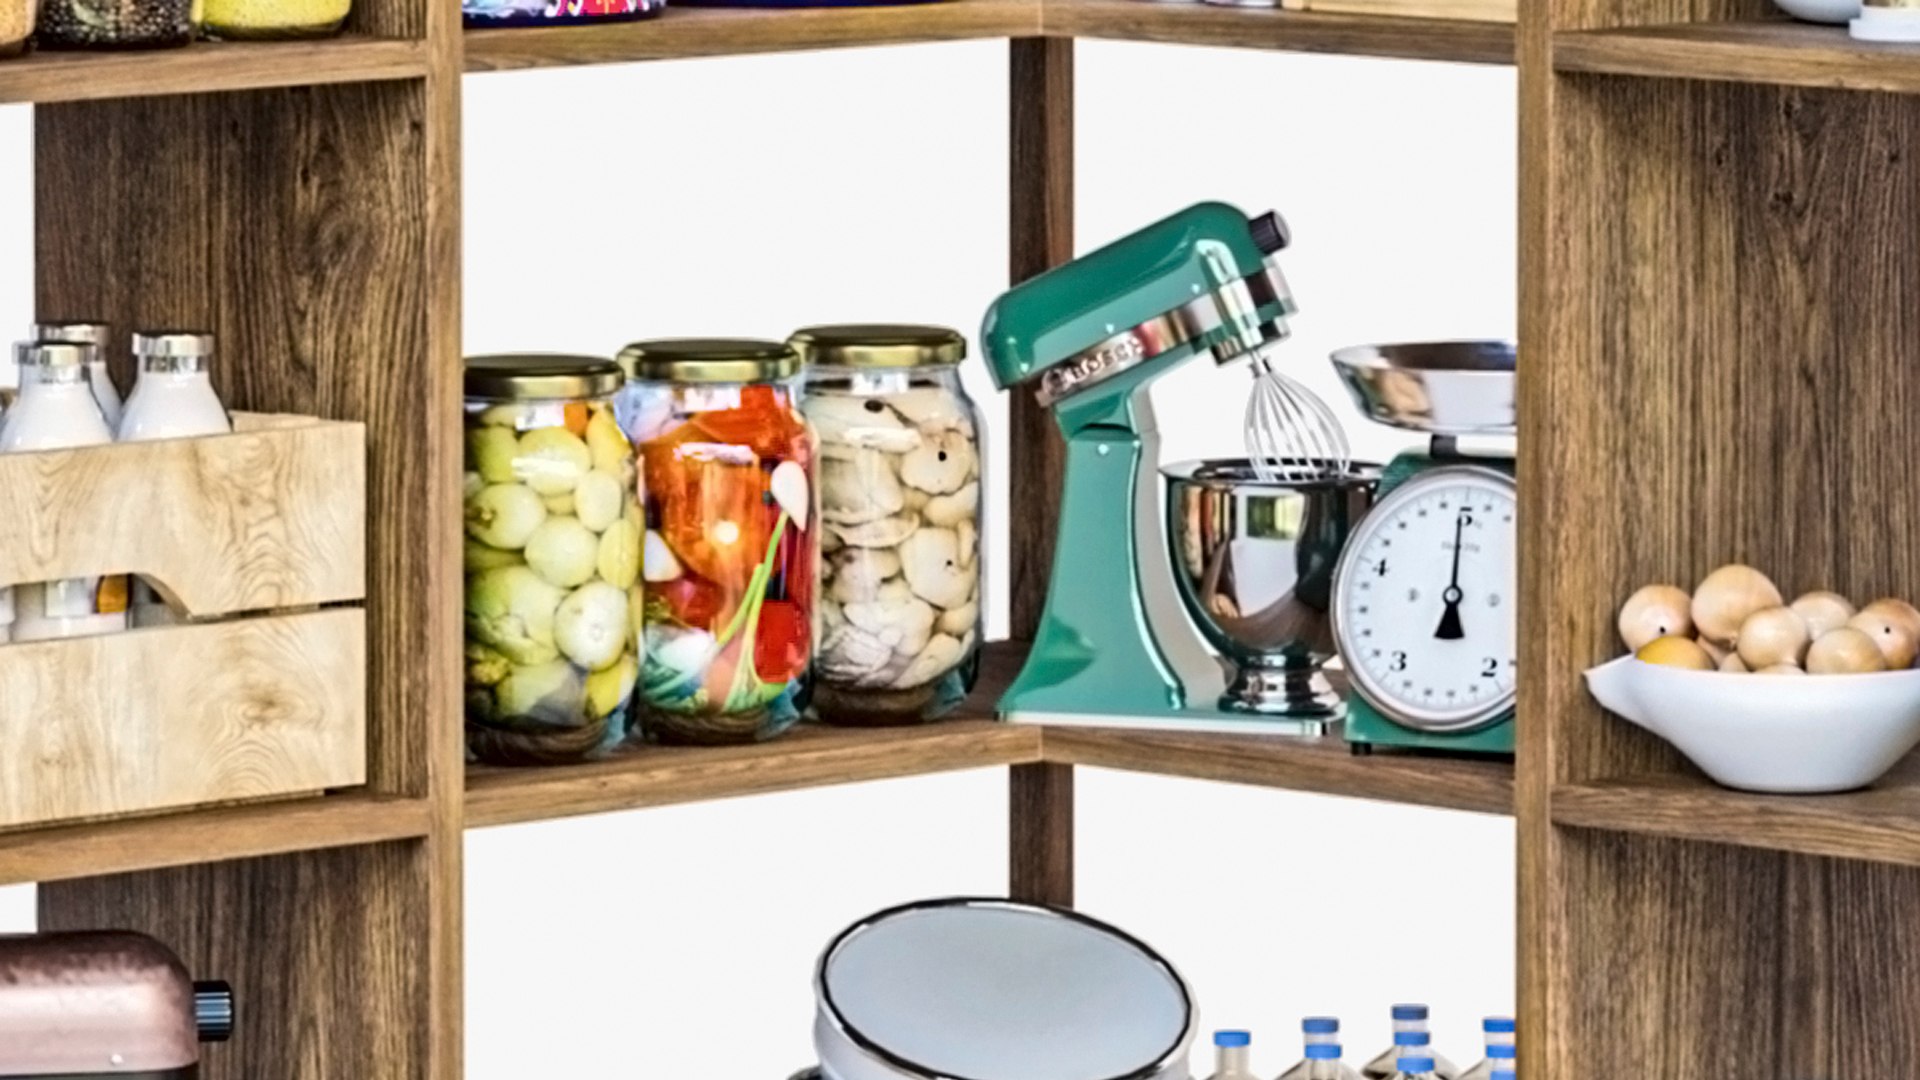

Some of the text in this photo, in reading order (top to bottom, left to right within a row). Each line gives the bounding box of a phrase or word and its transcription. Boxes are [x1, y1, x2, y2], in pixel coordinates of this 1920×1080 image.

[1458, 506, 1473, 526] 5
[1372, 558, 1389, 577] 4
[1390, 651, 1407, 672] 3
[1481, 656, 1498, 677] 2
